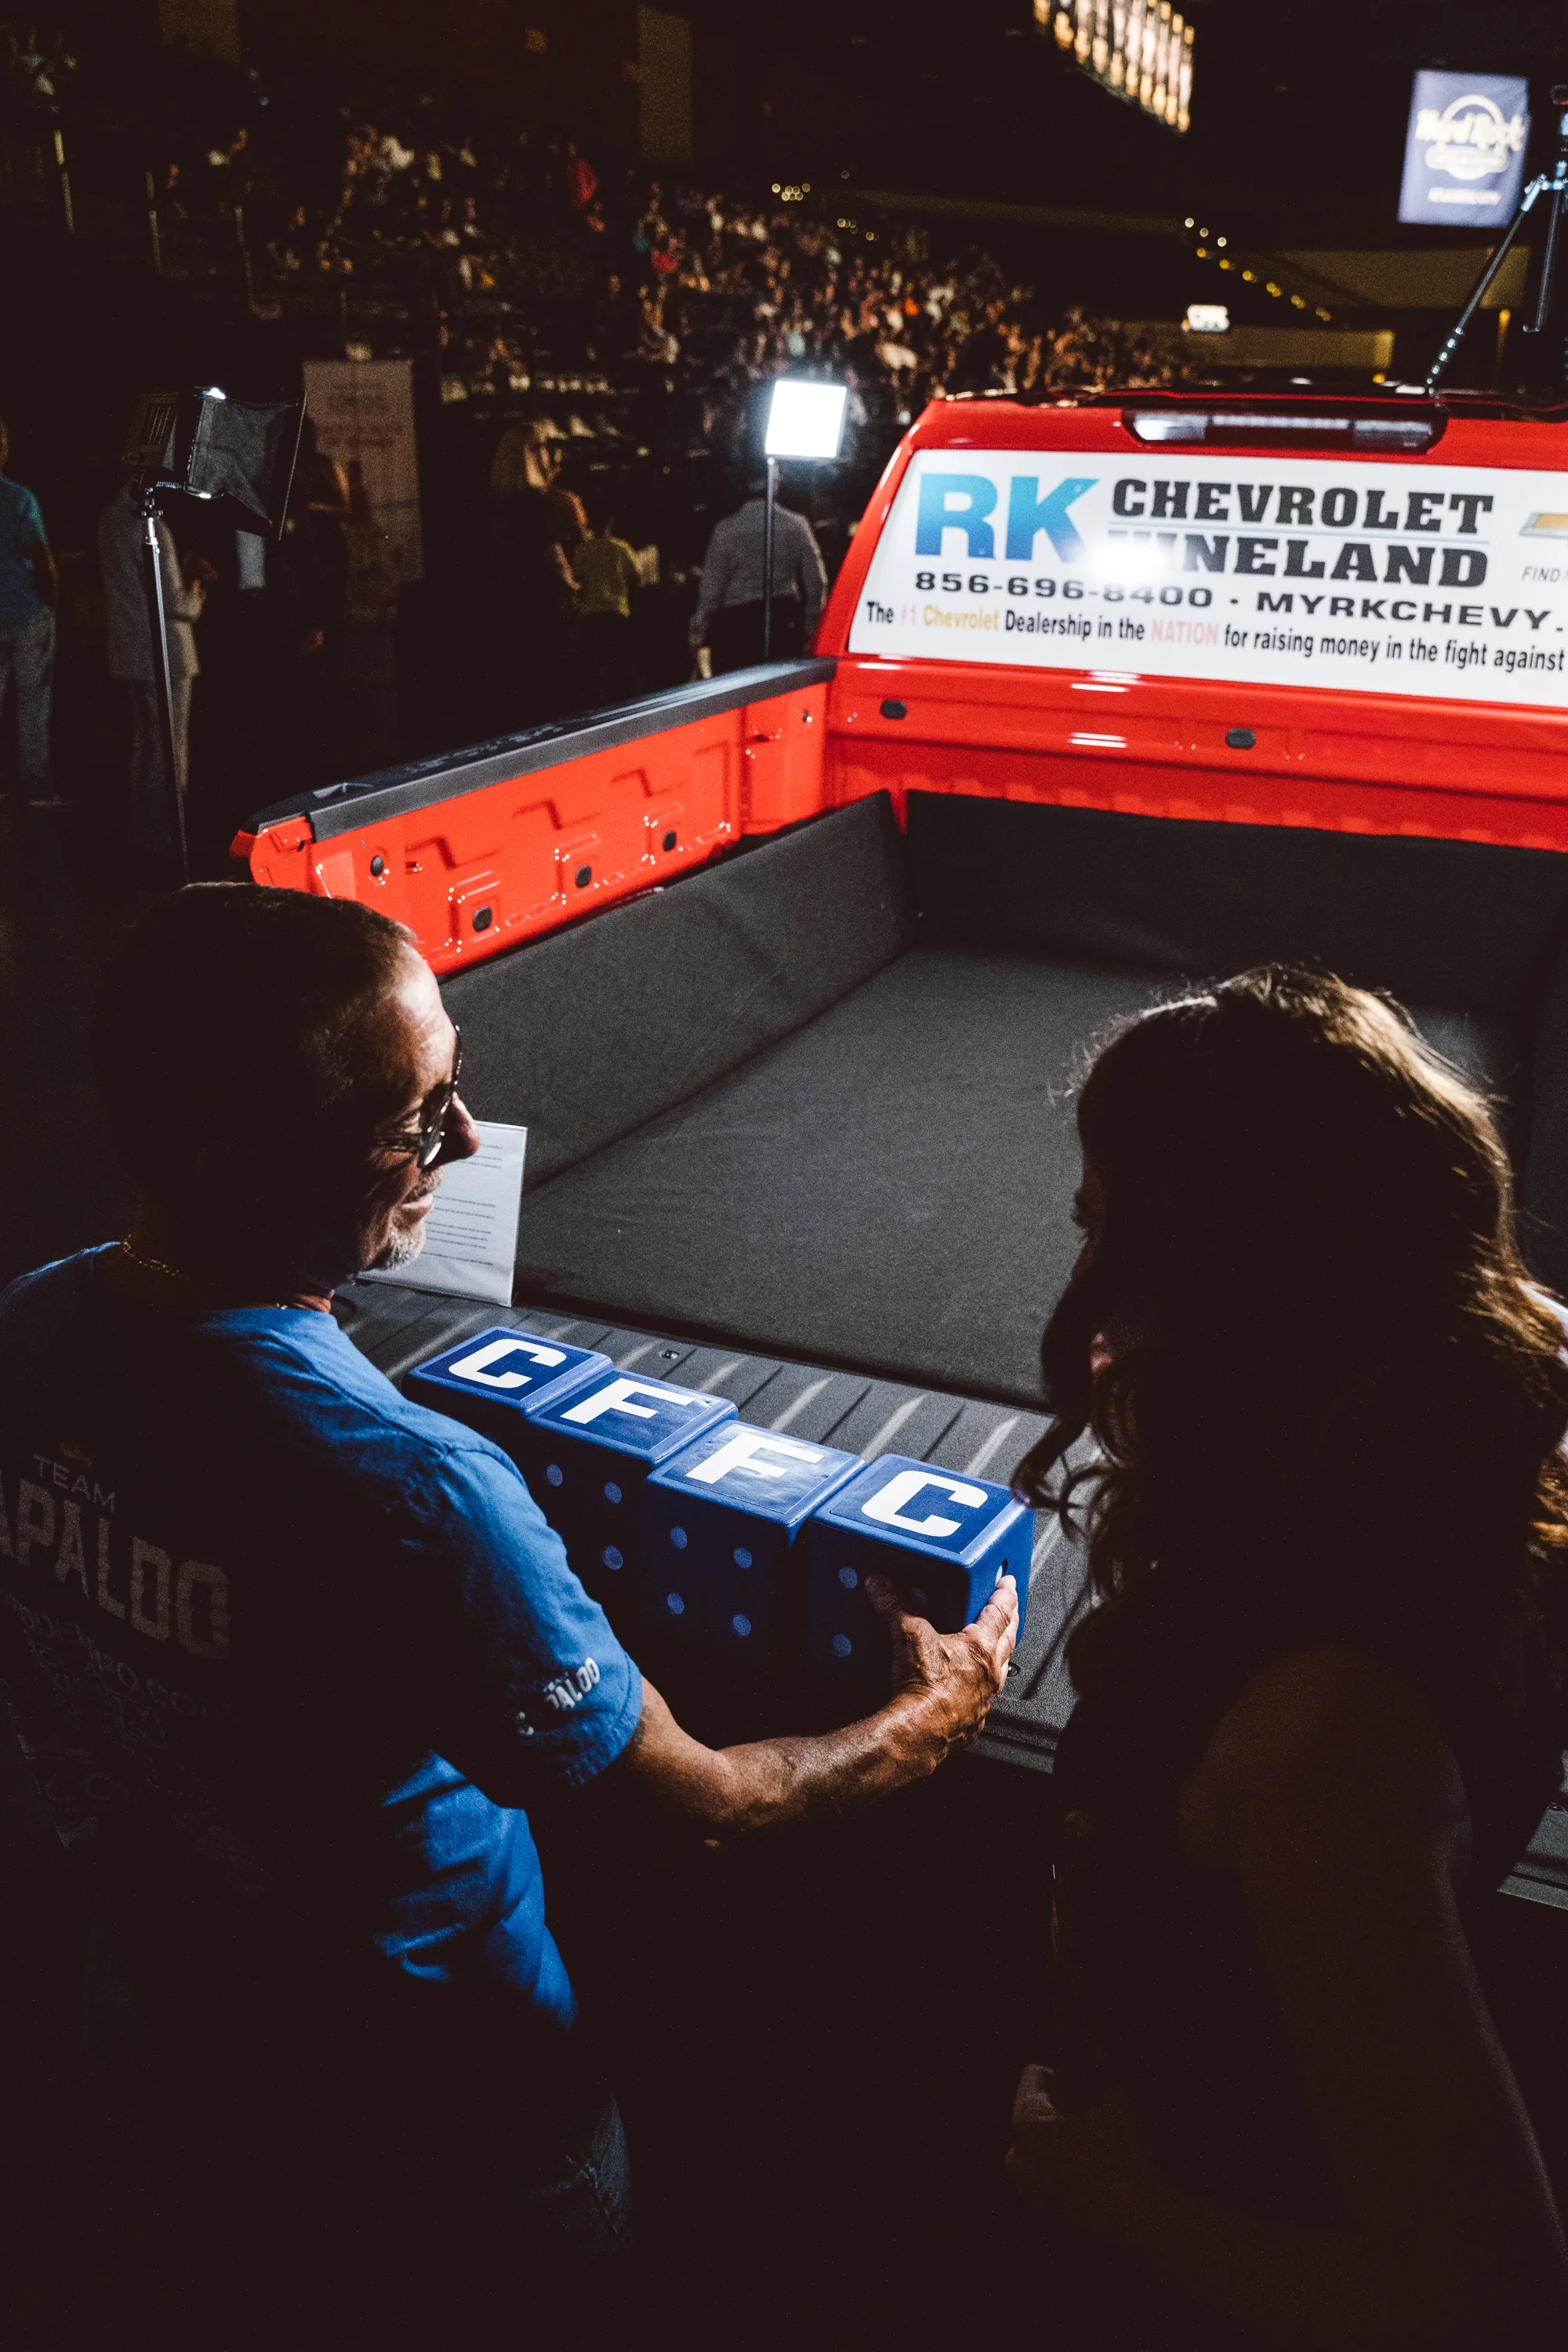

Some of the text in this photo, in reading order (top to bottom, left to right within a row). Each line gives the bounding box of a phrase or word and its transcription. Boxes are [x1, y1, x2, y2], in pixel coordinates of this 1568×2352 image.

[915, 473, 1100, 564] RK
[1112, 478, 1494, 534] CHEVROLET
[1108, 529, 1488, 587] NELAND
[1522, 566, 1561, 583] FIND
[915, 572, 1213, 608] 856-696-8400
[866, 601, 895, 624] The
[924, 604, 1000, 630] Chevrolet
[1005, 609, 1093, 642] Dealership
[1098, 614, 1112, 639] in
[1119, 618, 1145, 641] the
[1151, 619, 1219, 645] NATION
[1225, 623, 1249, 648] for
[1254, 626, 1314, 658] raising
[1320, 636, 1381, 662] money
[1386, 634, 1403, 659] in
[1410, 637, 1438, 662] the
[1446, 641, 1487, 669] fight
[1494, 645, 1565, 673] against
[33, 1454, 115, 1514] TEAM
